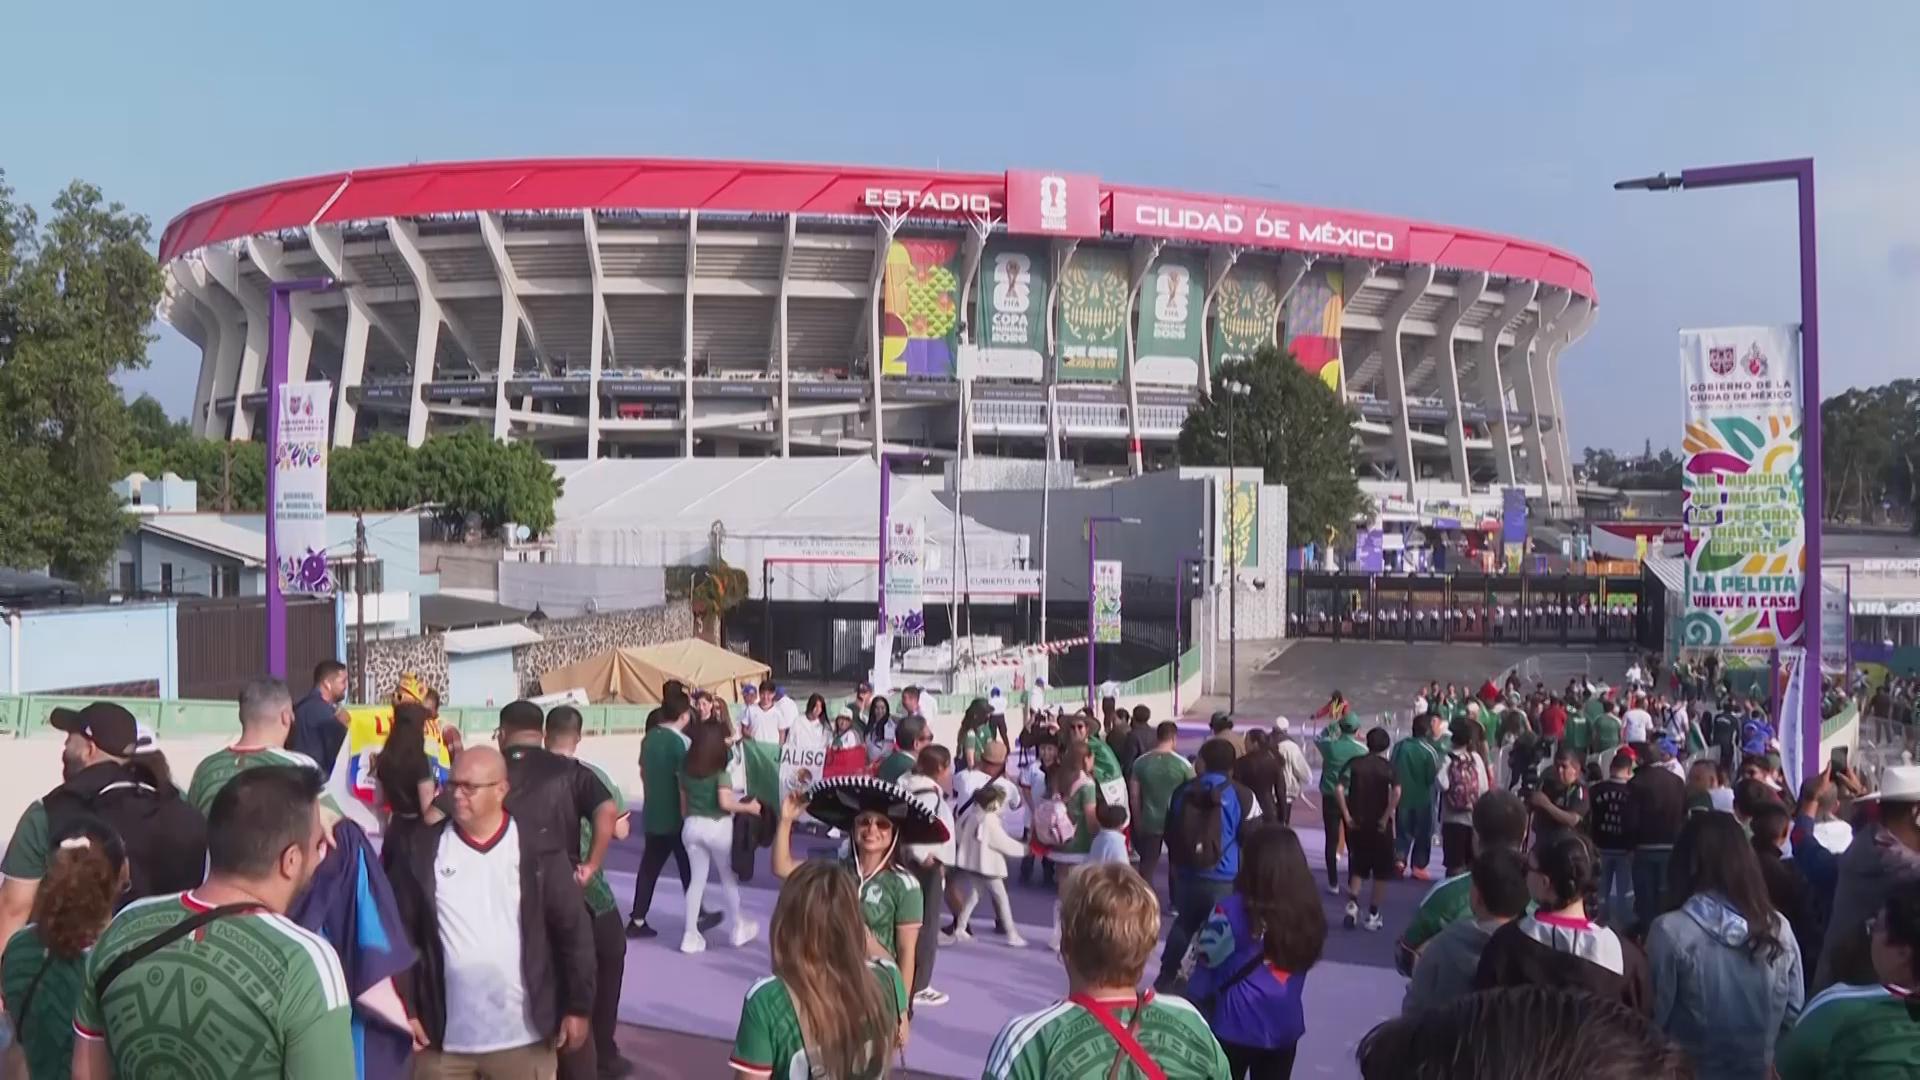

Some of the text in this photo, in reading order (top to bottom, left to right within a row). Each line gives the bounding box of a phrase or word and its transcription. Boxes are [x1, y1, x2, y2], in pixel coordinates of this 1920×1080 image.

[865, 187, 990, 213] ESTADIO
[1136, 205, 1394, 251] CIUDAD DE MÉXICO
[993, 313, 1028, 326] COPA
[1690, 380, 1791, 392] GOBIERNO DE LA
[1690, 390, 1792, 402] CIUDAD DE MÉXICO
[1725, 474, 1791, 486] MUNDIAL
[1692, 490, 1799, 505] QUE MUEVE A
[1724, 509, 1800, 521] PERSONAS
[1772, 525, 1798, 538] DEL
[1711, 541, 1777, 555] DEPORTE
[1693, 576, 1797, 592] LA PELOTA
[1693, 595, 1797, 608] VUELVE A CASA
